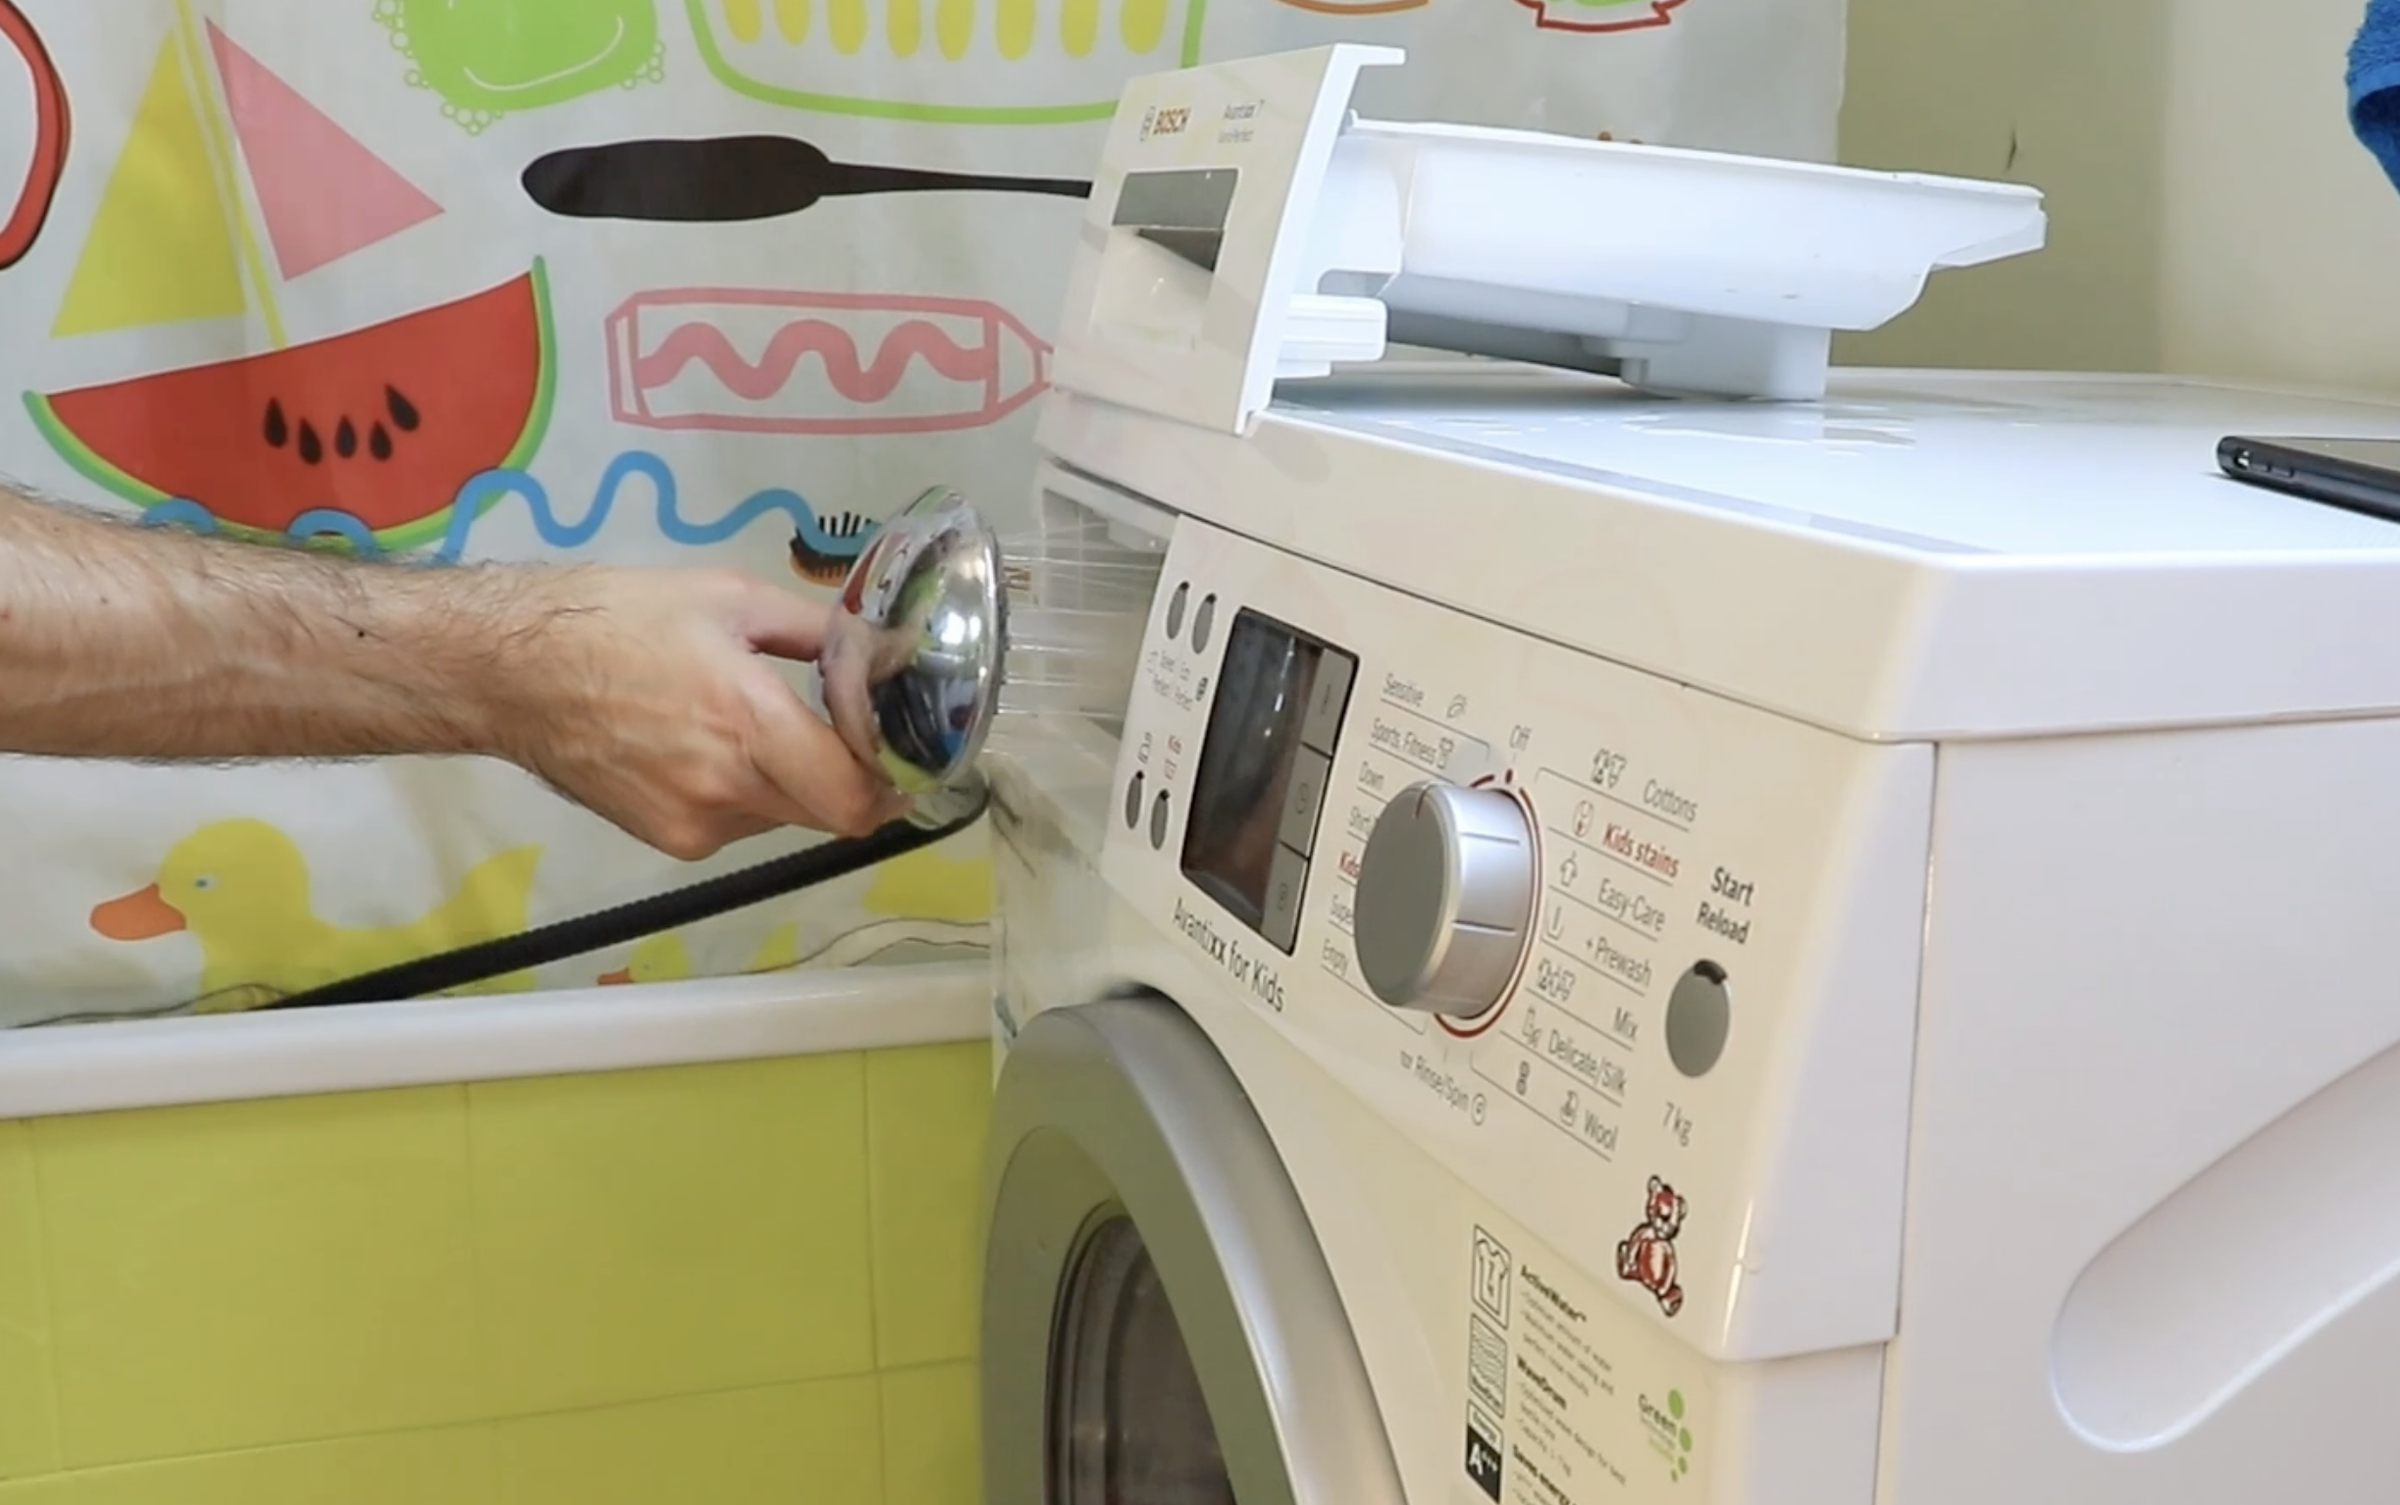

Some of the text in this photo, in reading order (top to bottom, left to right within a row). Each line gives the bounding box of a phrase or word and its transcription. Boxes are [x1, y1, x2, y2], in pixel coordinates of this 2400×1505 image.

[1153, 106, 1191, 135] BOSCH
[1383, 672, 1425, 708] Sensitive
[1510, 725, 1531, 751] Off
[1359, 761, 1385, 791] Down
[1643, 779, 1698, 823] Cottons
[1603, 823, 1680, 878] Kids stains
[1598, 878, 1666, 932] Easy-Care
[1711, 866, 1754, 906] Start
[1696, 901, 1750, 944] Reload
[1173, 896, 1285, 1013] Avantixx for Kids
[1322, 938, 1349, 977] Empty
[1613, 1006, 1639, 1042] Mix
[1414, 1055, 1470, 1112] Rinse/Spin
[1548, 1028, 1627, 1096] Delicate/Silk
[1584, 1110, 1619, 1152] Wool
[1664, 1102, 1693, 1148] 7 kg
[1638, 1394, 1678, 1437] Green
